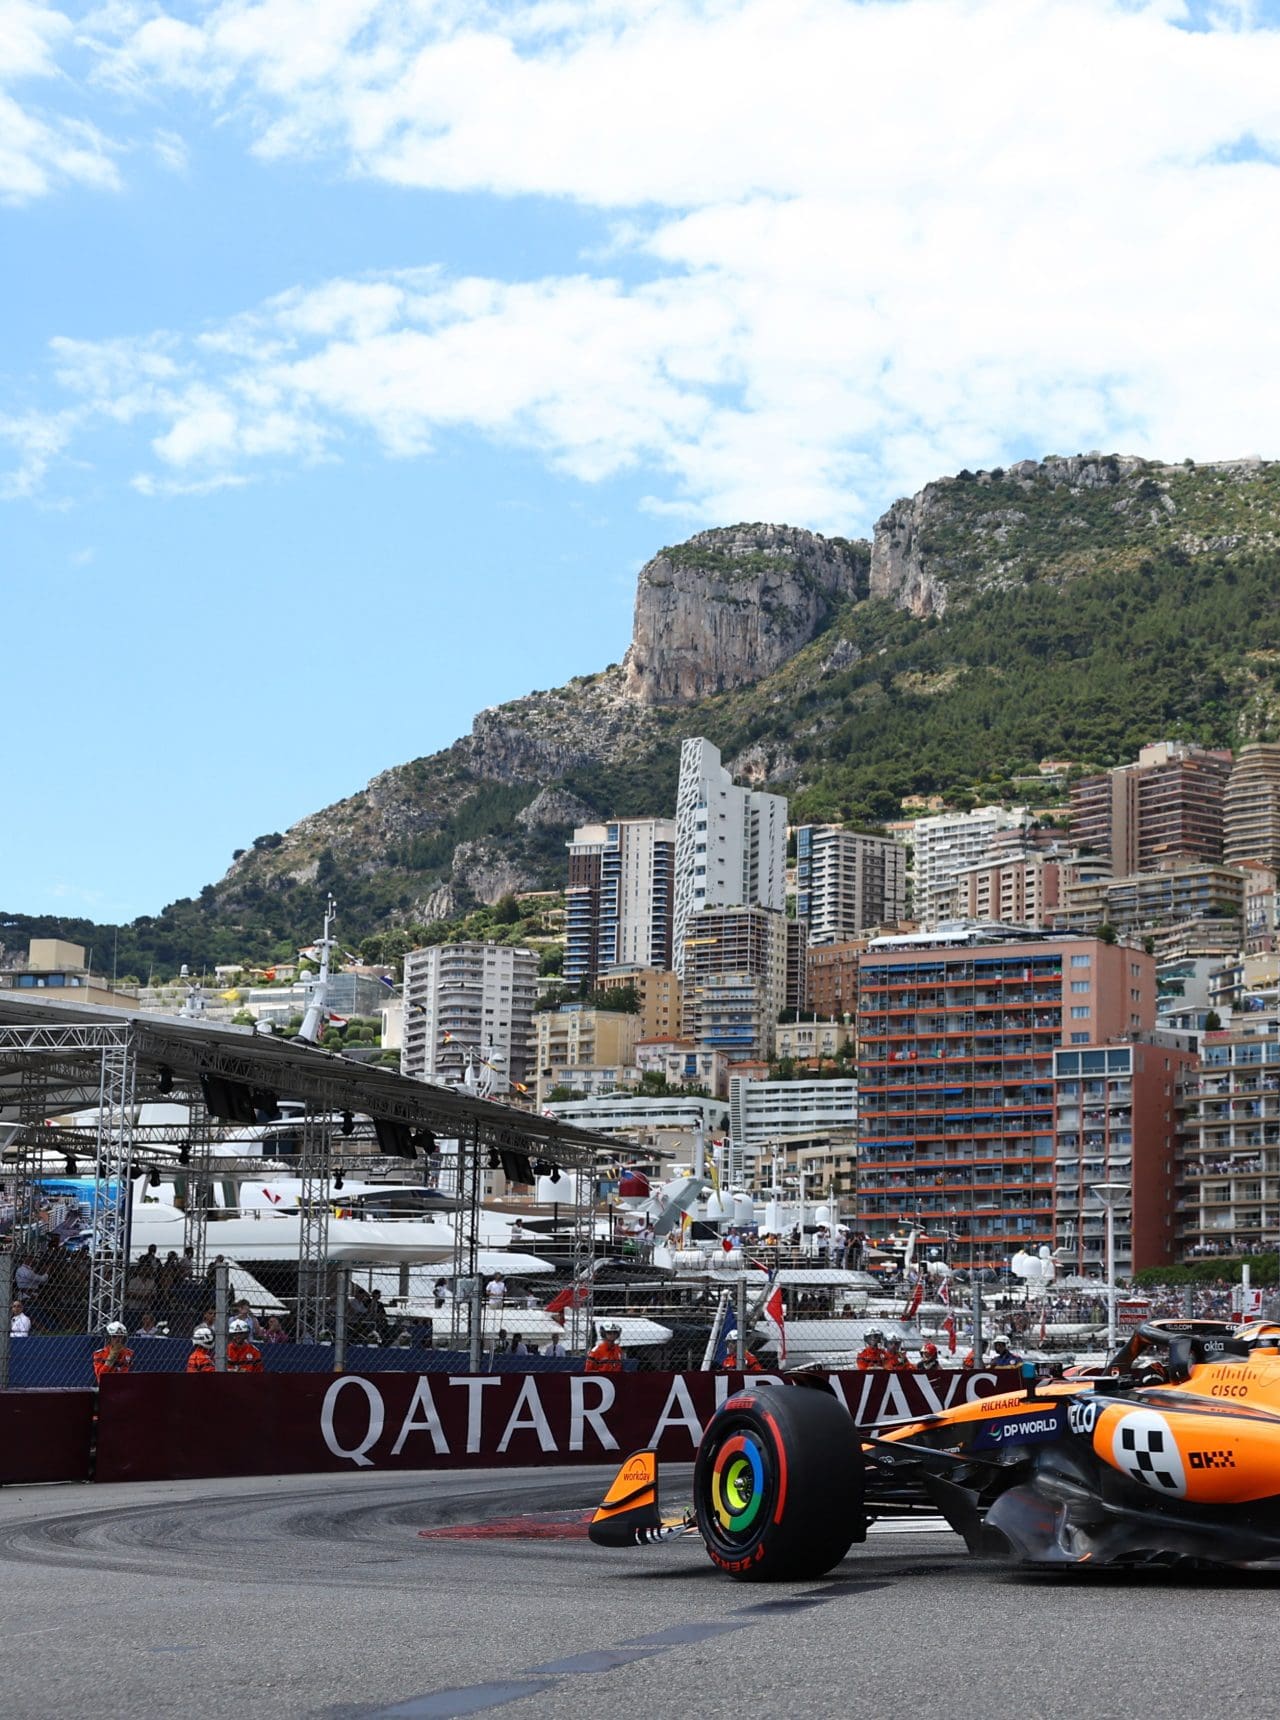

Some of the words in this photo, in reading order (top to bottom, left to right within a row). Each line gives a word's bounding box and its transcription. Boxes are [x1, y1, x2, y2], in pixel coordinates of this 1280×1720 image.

[1203, 1341, 1225, 1352] okta
[1211, 1384, 1248, 1397] CISCO
[981, 1397, 1021, 1412] RICHARD
[320, 1374, 621, 1466] QATAR
[1004, 1424, 1019, 1437] DP
[1019, 1419, 1058, 1434] WORLD
[1188, 1450, 1236, 1468] OKX
[623, 1471, 650, 1482] workday
[710, 1551, 752, 1572] ZERO
